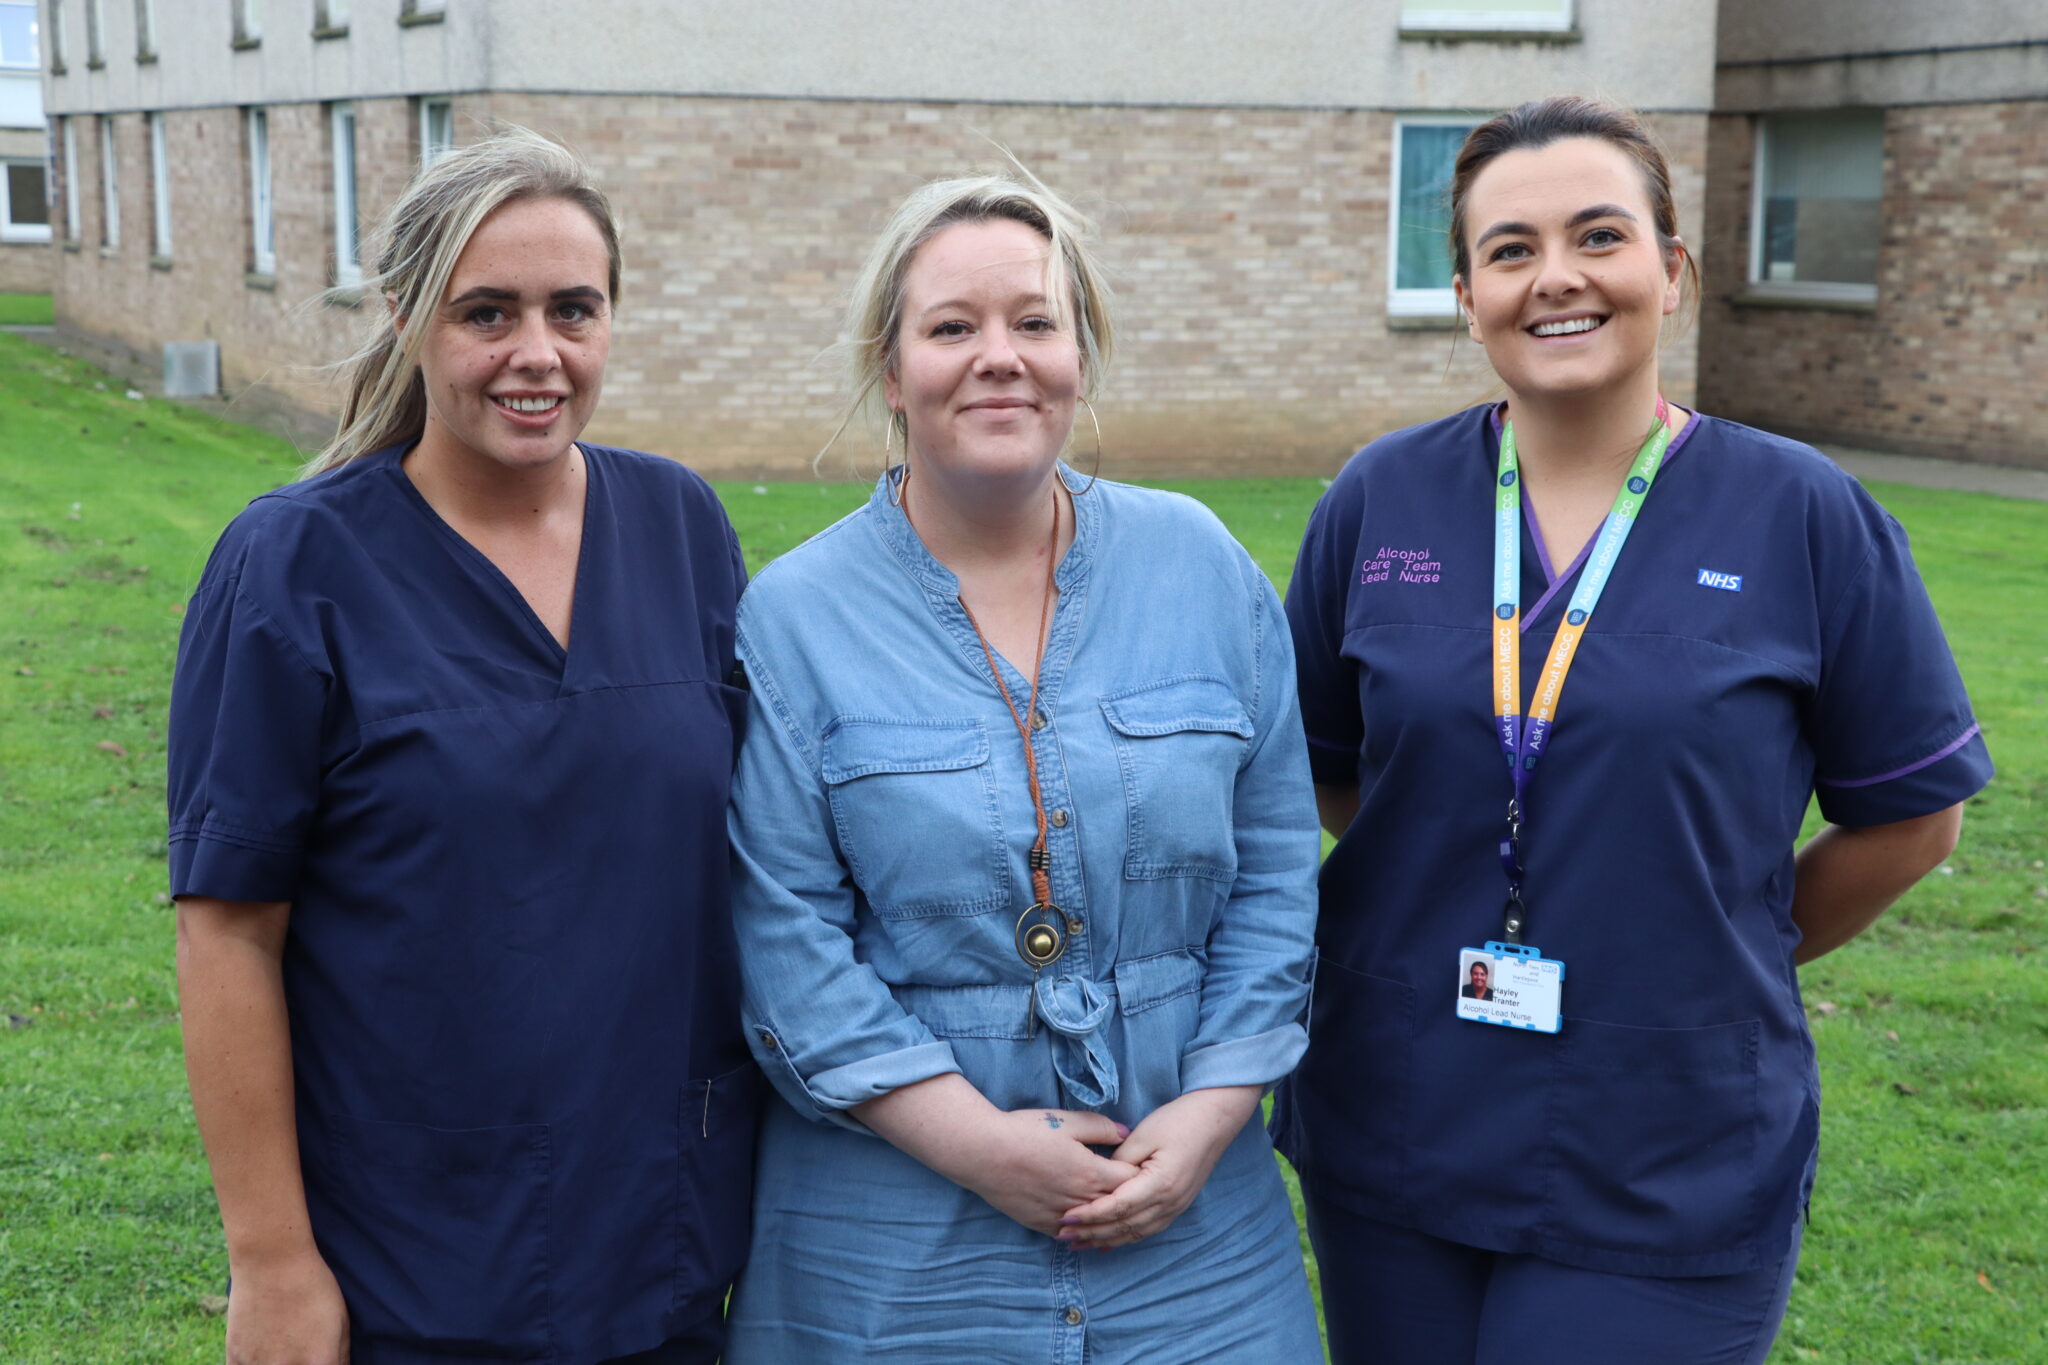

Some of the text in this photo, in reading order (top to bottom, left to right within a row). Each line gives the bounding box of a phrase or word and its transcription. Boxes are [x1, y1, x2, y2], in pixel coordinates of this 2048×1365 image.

[1640, 455, 1656, 475] Ask
[1651, 438, 1662, 455] me
[1502, 493, 1513, 526] MECC
[1376, 546, 1430, 560] Alcohol
[1502, 528, 1513, 560] about
[1579, 499, 1634, 607] Ask me about MECC
[1362, 560, 1441, 572] Care Team
[1503, 562, 1513, 579] me
[1361, 569, 1440, 585] Lead Nurse
[1699, 570, 1741, 589] NHS
[1501, 580, 1513, 600] Ask
[1500, 627, 1512, 663] MECC
[1553, 632, 1575, 668] MECC
[1500, 665, 1512, 700] about
[1542, 670, 1561, 705] about
[1502, 703, 1512, 722] me
[1536, 707, 1549, 726] me
[1502, 724, 1513, 746] Ask
[1529, 728, 1544, 751] Ask
[1493, 987, 1519, 998] Hayley
[1493, 996, 1520, 1007] Tranter
[1463, 1003, 1532, 1021] Alcohol Lead Nurse
